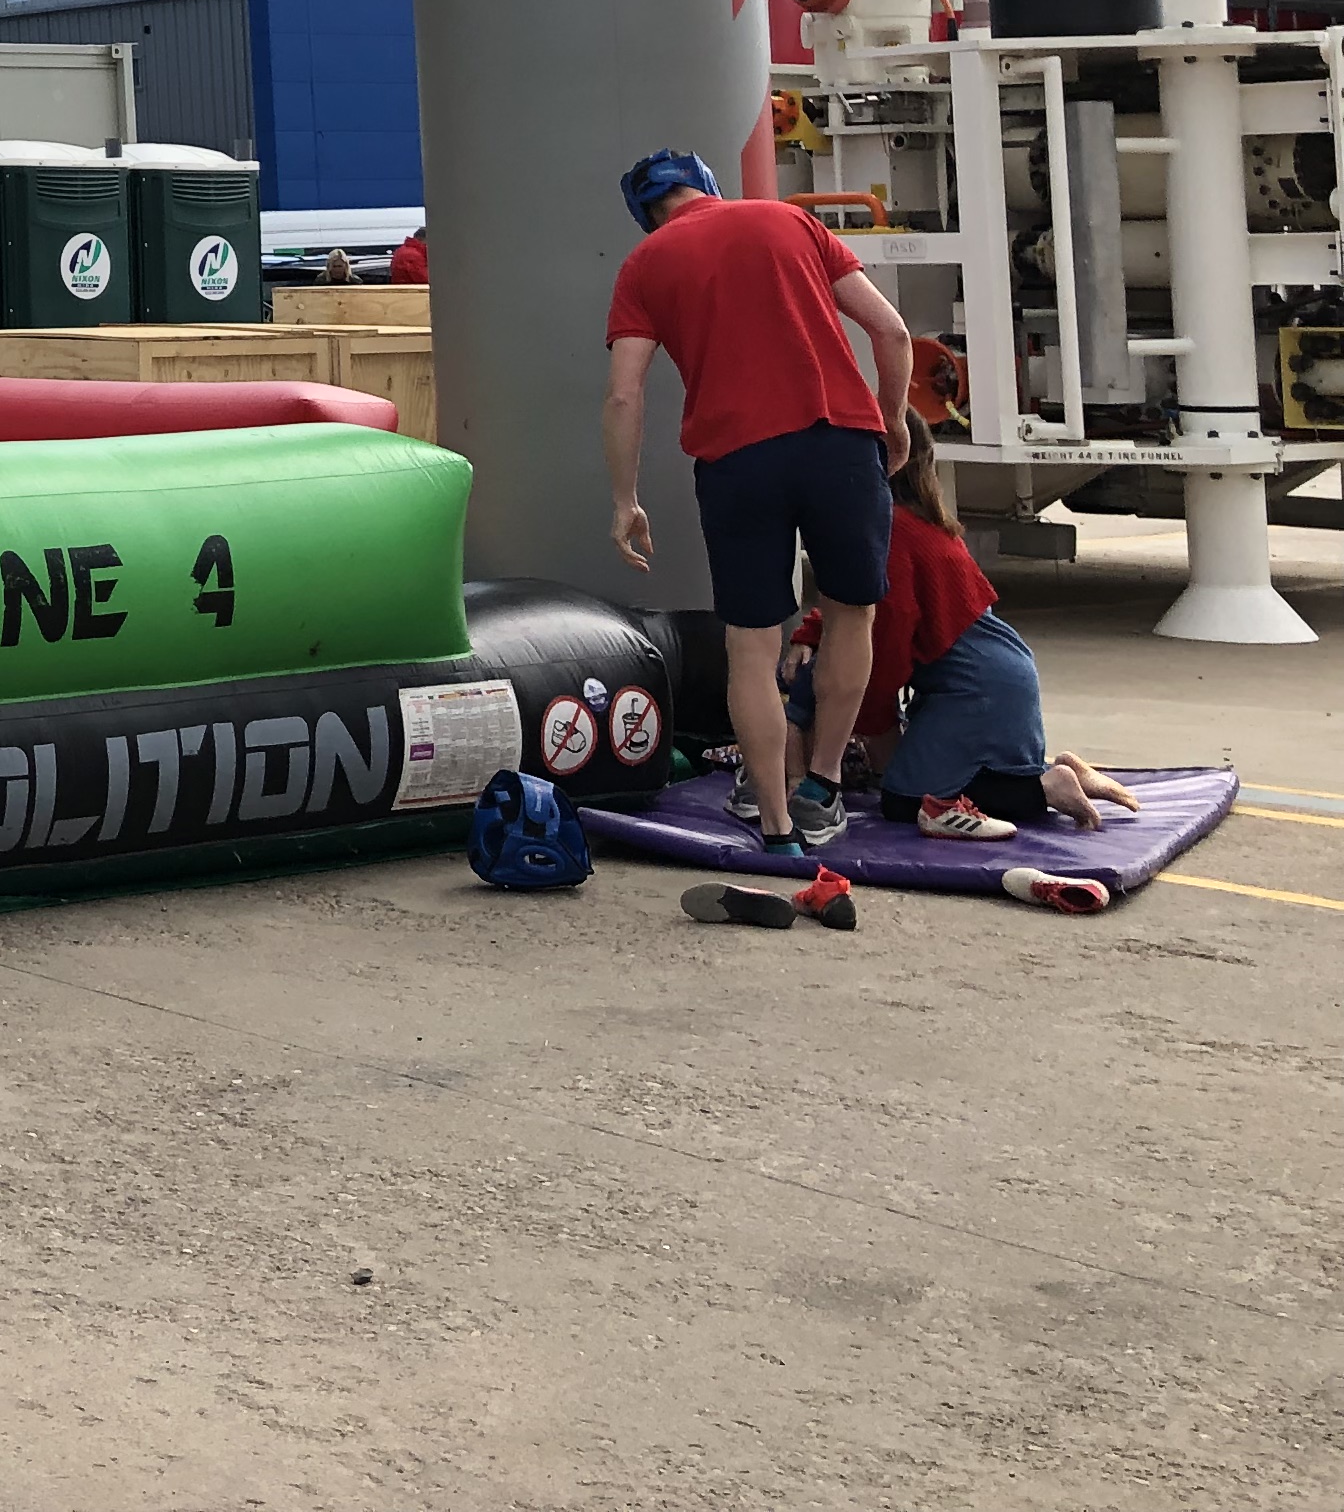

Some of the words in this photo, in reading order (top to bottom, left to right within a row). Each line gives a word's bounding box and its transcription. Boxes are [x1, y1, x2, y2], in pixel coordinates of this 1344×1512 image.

[72, 275, 100, 283] NIXON
[201, 278, 229, 286] NIXON
[1140, 451, 1184, 461] FUNNEL
